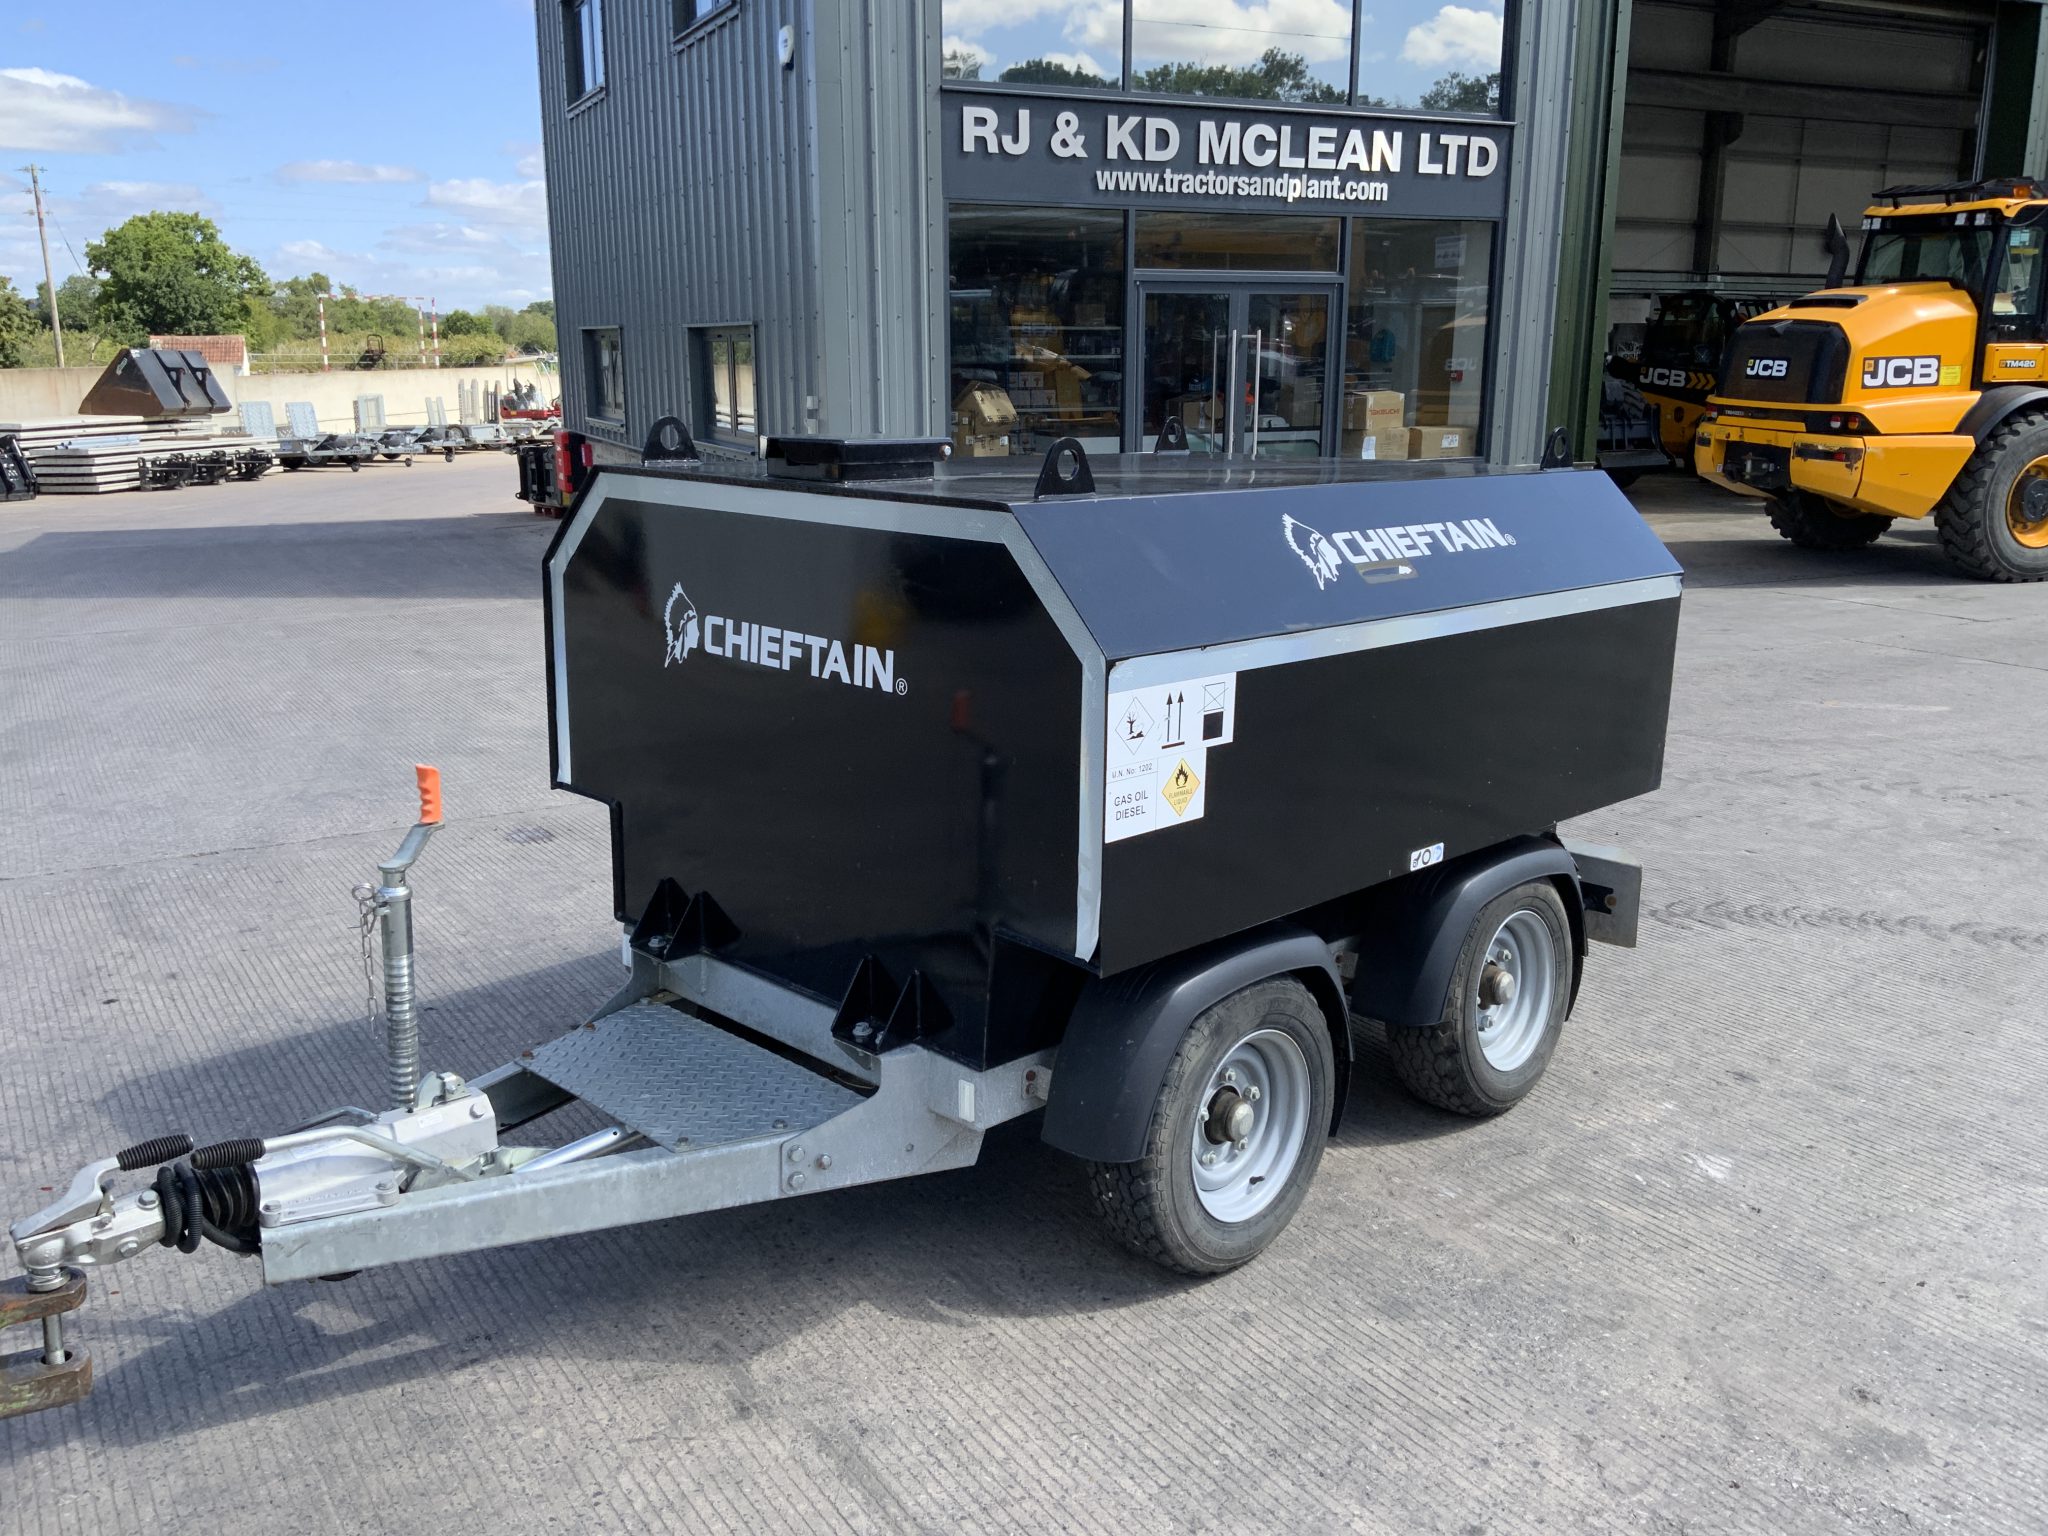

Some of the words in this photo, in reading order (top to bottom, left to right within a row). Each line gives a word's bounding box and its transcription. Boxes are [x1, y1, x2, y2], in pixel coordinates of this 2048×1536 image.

[962, 106, 1031, 157] RJ
[1050, 111, 1088, 159] &
[1106, 114, 1181, 163] KD
[1198, 119, 1403, 173] MCLEAN
[1417, 132, 1499, 178] LTD
[1095, 168, 1389, 203] www.tractorsandplant.com
[1746, 358, 1788, 378] JCB
[1863, 357, 1939, 387] JCB
[2006, 360, 2036, 368] TM420
[1639, 367, 1686, 388] JCB
[1114, 794, 1132, 806] GAS
[1135, 790, 1148, 801] OIL
[1116, 805, 1146, 820] DIESEL
